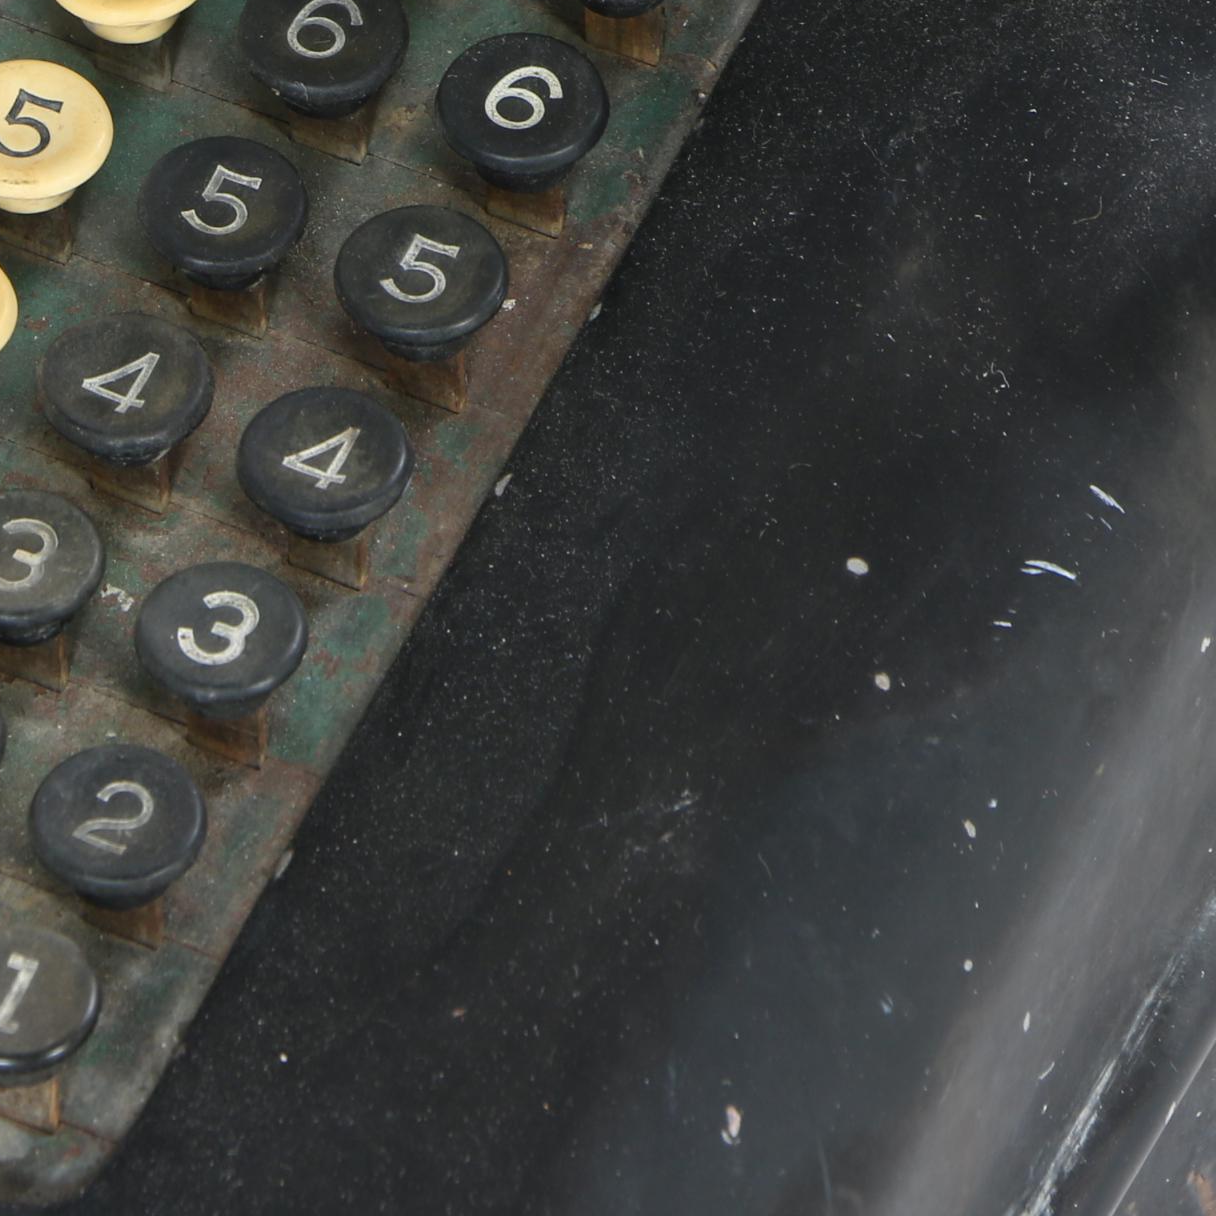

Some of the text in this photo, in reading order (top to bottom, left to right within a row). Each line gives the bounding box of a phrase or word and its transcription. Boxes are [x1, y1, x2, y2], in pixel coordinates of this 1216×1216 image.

[485, 66, 562, 129] 6
[182, 164, 261, 234] 5
[381, 234, 459, 302] 5
[82, 352, 158, 413] 4
[282, 428, 357, 489] 4
[177, 591, 259, 664] 3
[75, 780, 154, 854] 2
